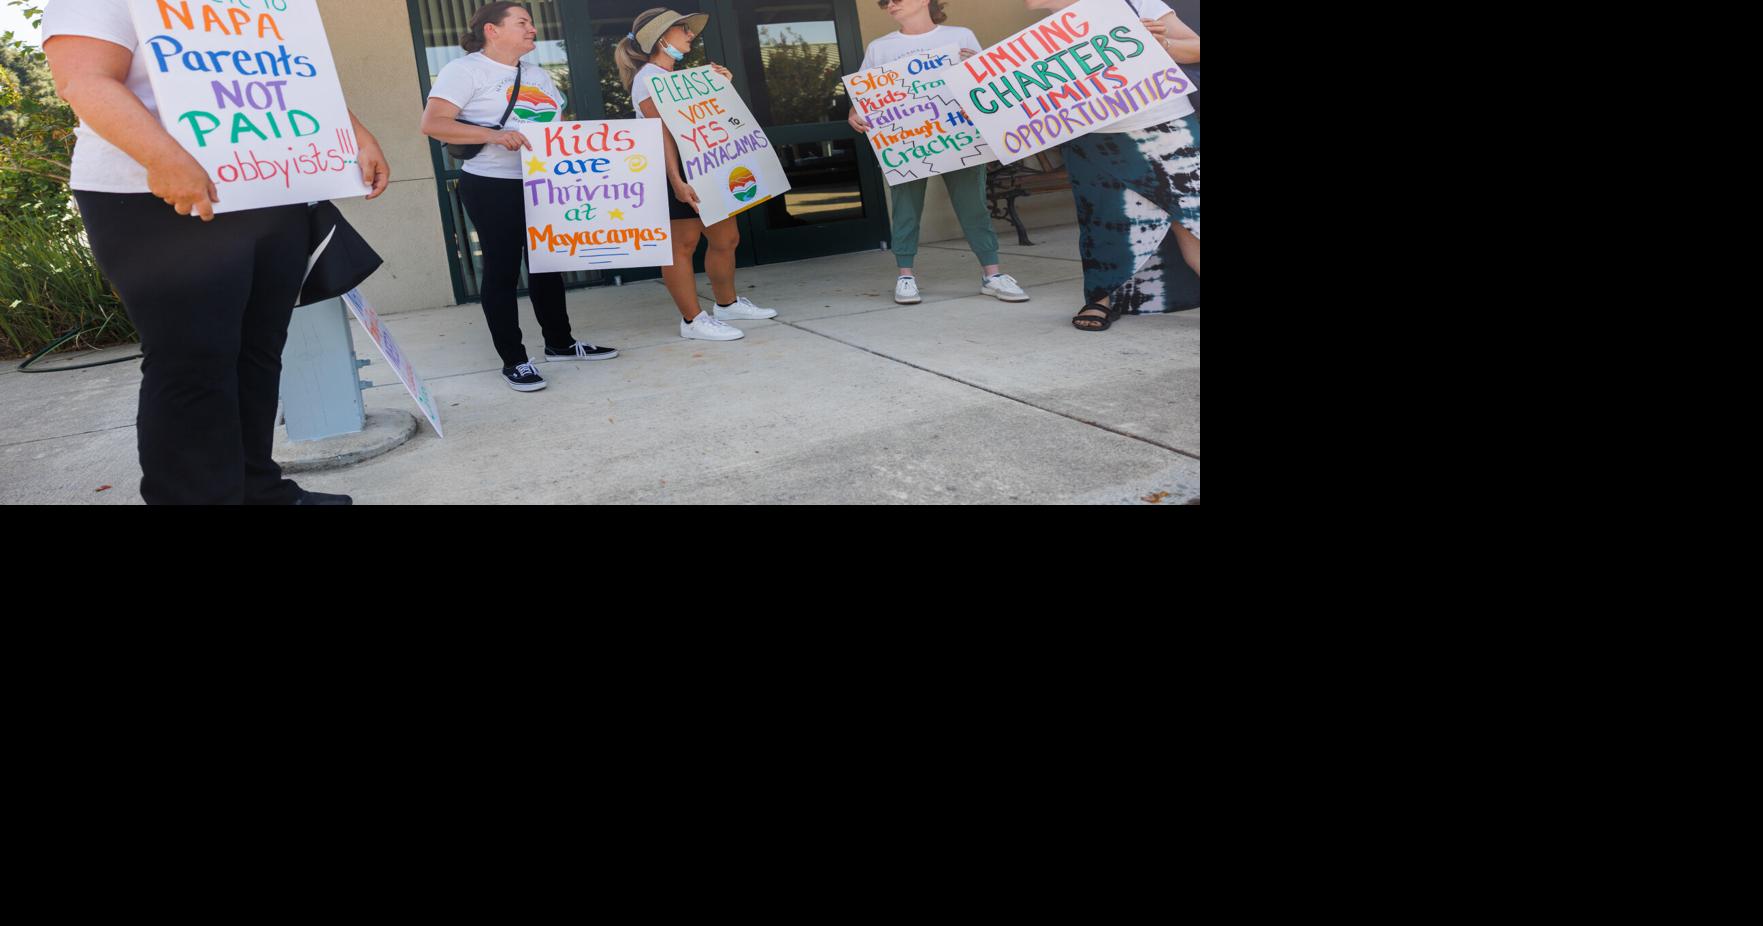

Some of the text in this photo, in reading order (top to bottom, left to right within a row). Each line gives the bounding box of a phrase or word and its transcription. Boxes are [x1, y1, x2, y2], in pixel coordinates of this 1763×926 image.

[157, 0, 285, 41] NAPA
[146, 35, 317, 78] Parents
[964, 11, 1090, 84] LIMITING
[651, 70, 724, 104] PLEASE
[850, 70, 899, 95] Stop
[907, 54, 948, 75] Our
[969, 26, 1145, 115] CHARTERS
[211, 80, 288, 111] NOT
[859, 89, 908, 114] Kids
[1021, 66, 1129, 119] LIMITS
[678, 98, 726, 125] VOTE
[865, 101, 940, 129] Falling
[1003, 67, 1189, 154] OPPORTUNITIES
[178, 109, 320, 147] PAID
[544, 123, 635, 157] Kids
[681, 121, 729, 152] YES
[872, 120, 946, 149] Through
[213, 128, 357, 188] obbyists!!!
[553, 157, 610, 175] are
[686, 130, 768, 180] MAYACAMAS
[525, 175, 645, 208] Thriving
[564, 203, 597, 221] at
[528, 224, 667, 256] Mayacamas
